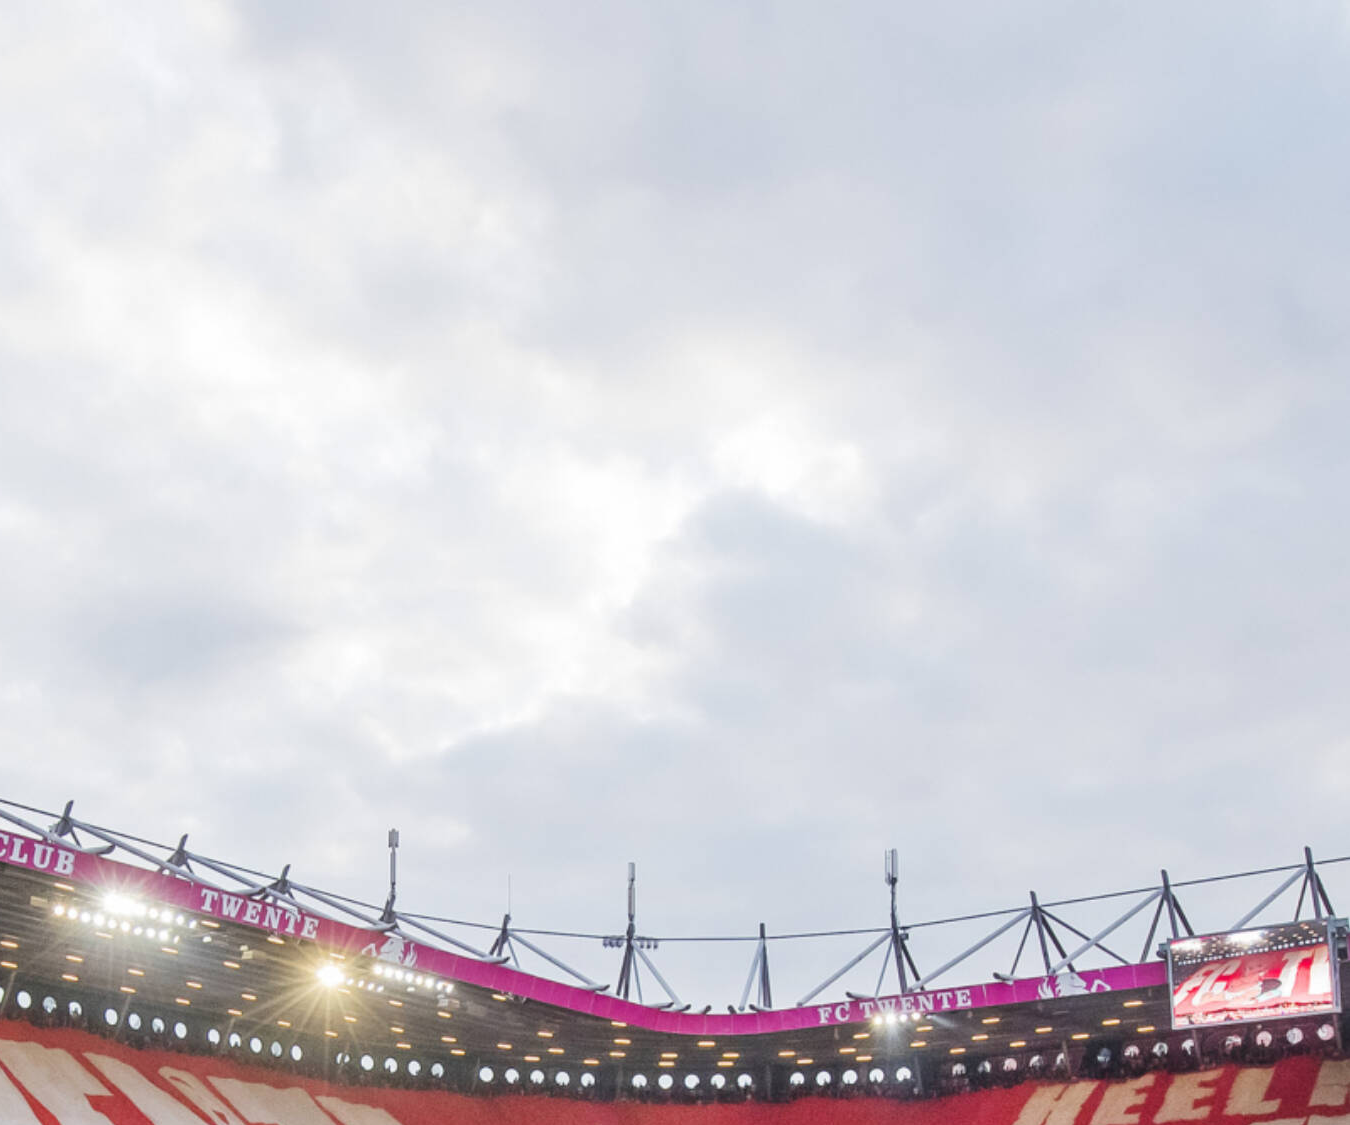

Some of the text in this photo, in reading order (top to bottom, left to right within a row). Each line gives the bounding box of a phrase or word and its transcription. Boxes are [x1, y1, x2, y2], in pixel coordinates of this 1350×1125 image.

[201, 888, 320, 939] TWENTE
[818, 989, 972, 1024] FC TWENTE
